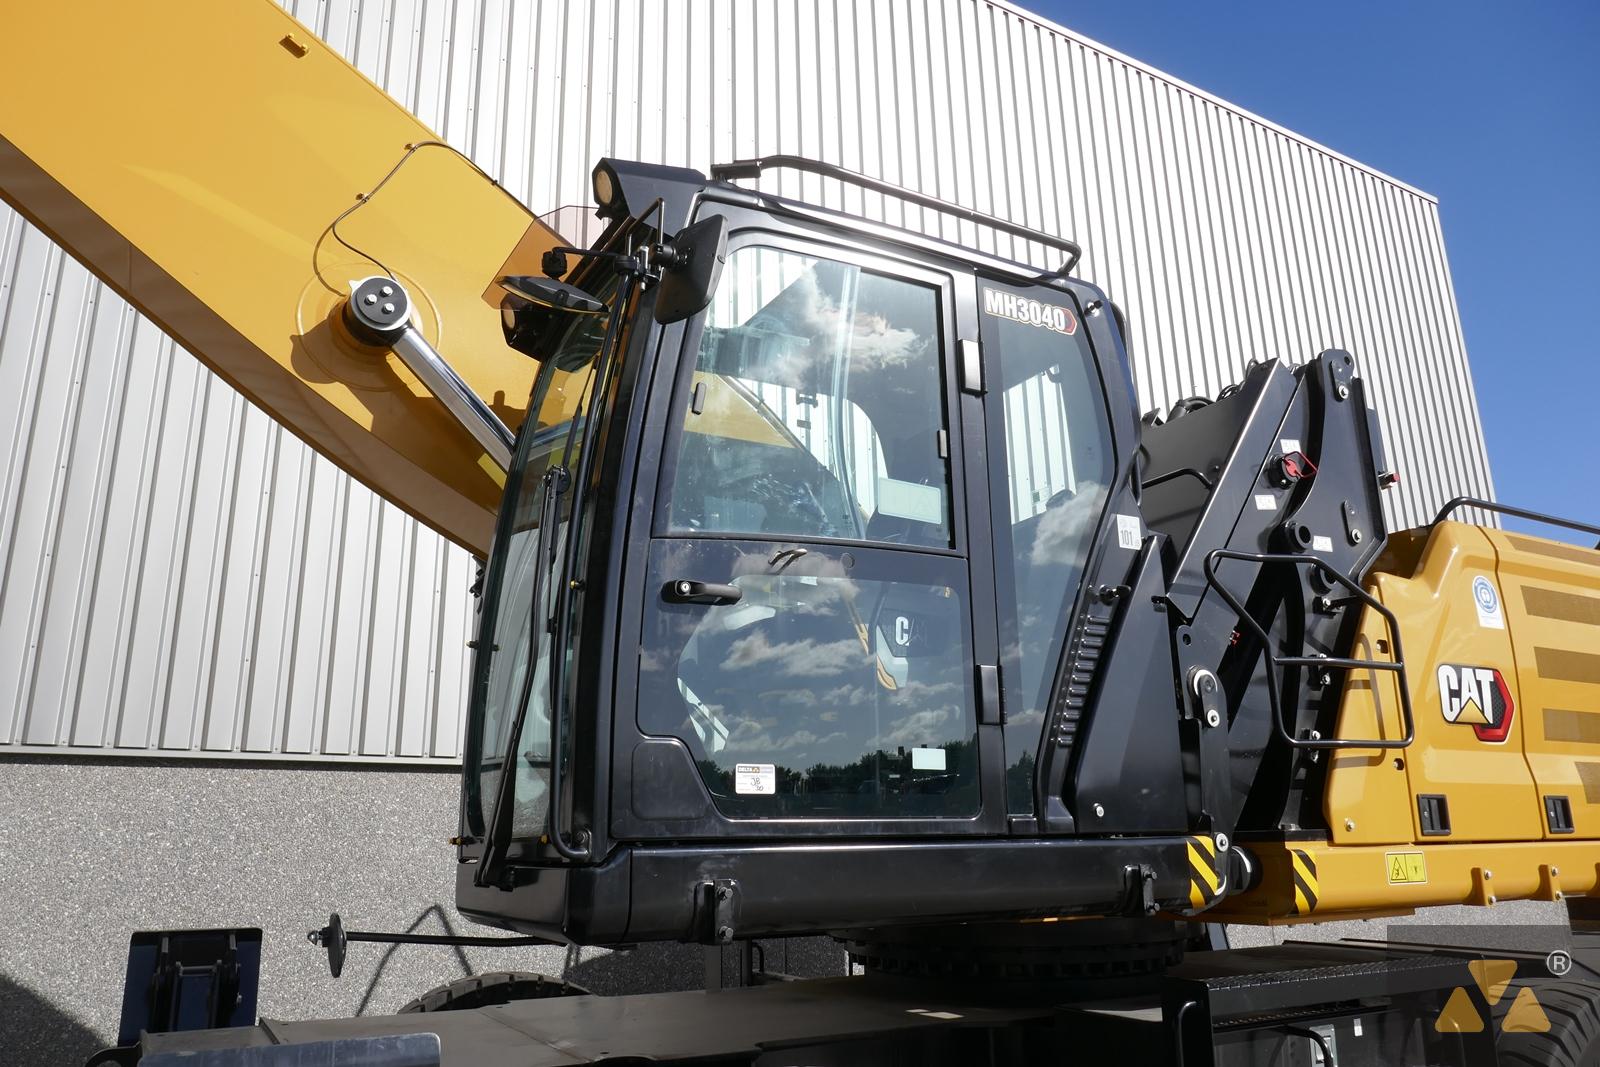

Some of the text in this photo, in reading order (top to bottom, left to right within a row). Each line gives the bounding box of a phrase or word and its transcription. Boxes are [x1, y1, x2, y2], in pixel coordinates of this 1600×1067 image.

[984, 288, 1066, 331] MH3040
[1120, 529, 1134, 546] 101
[1437, 664, 1495, 725] CAT
